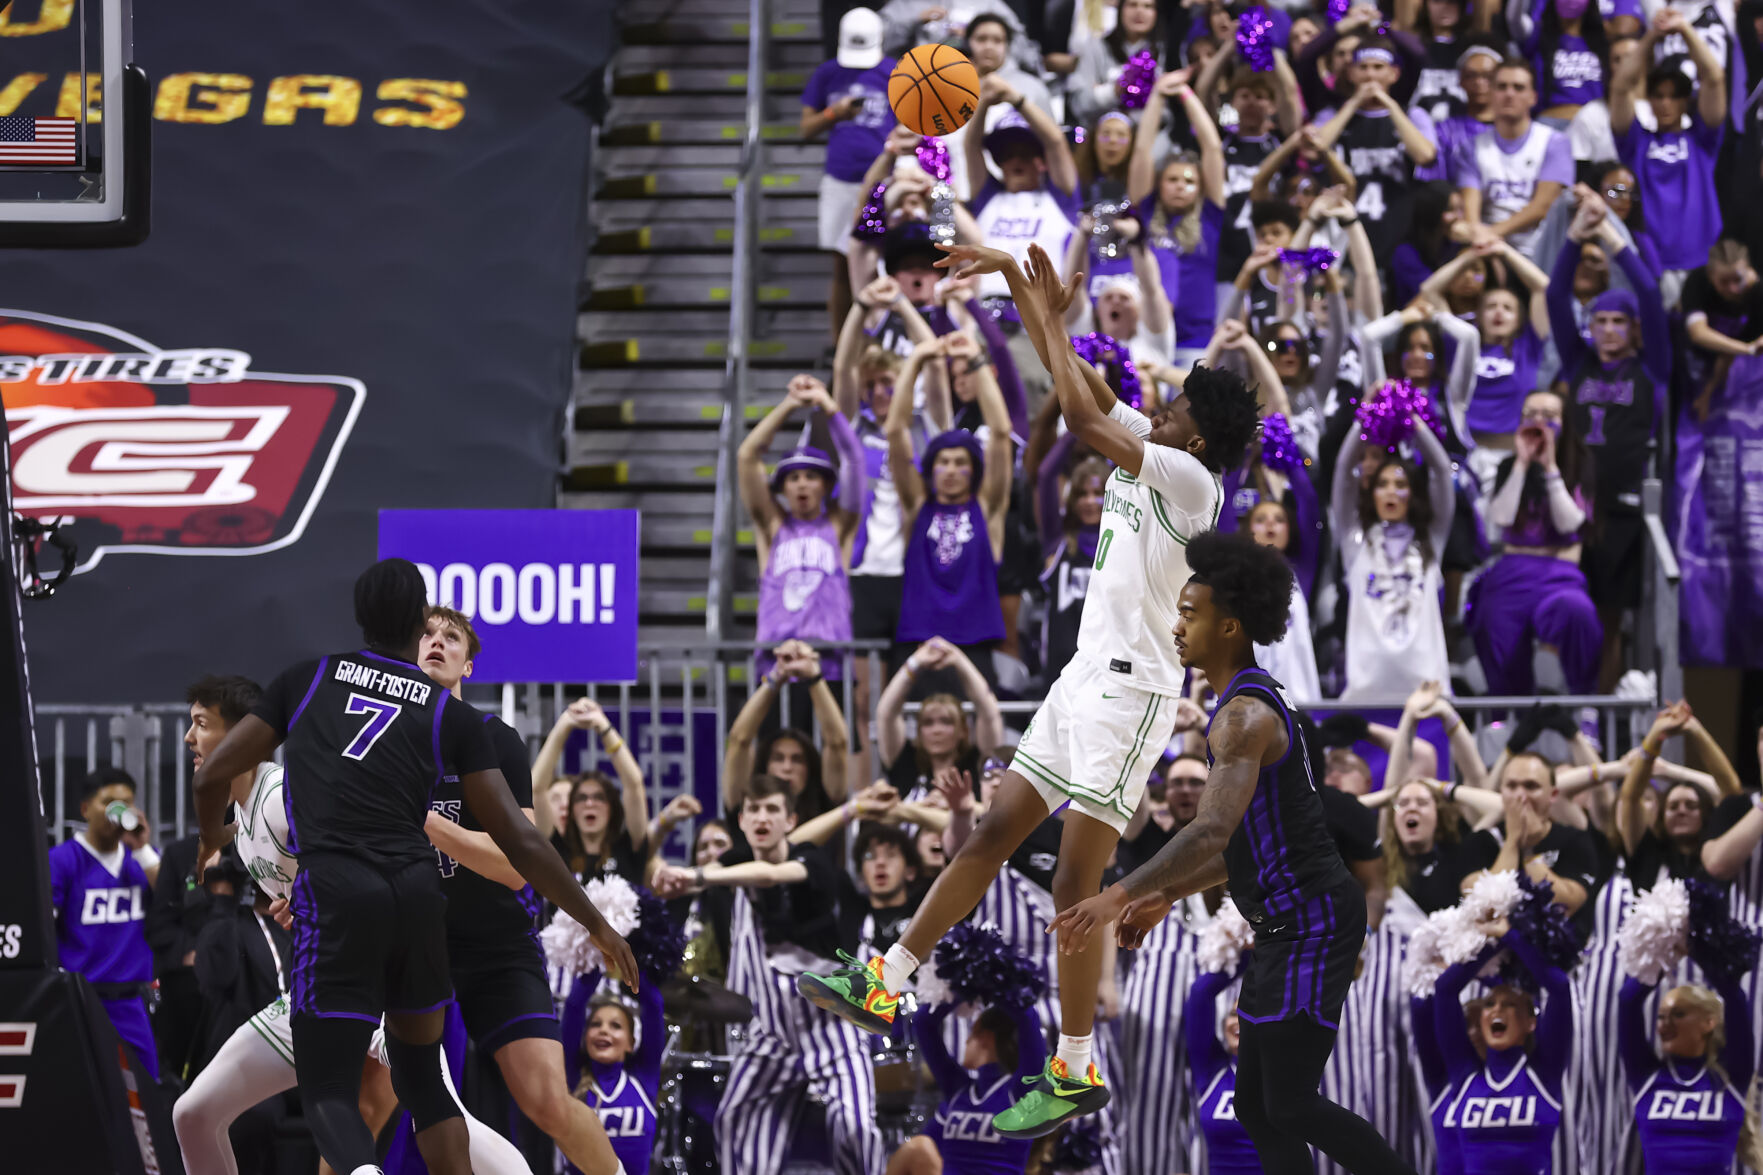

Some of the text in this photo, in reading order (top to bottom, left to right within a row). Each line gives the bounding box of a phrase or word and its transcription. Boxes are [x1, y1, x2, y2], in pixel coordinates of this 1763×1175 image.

[38, 349, 250, 385] TIRES
[1095, 528, 1114, 571] 0
[335, 660, 432, 706] GRANT-FOSTER
[341, 692, 402, 760] 7
[598, 1106, 645, 1137] CU
[1461, 1095, 1537, 1128] GCU
[1647, 1089, 1724, 1121] GCU
